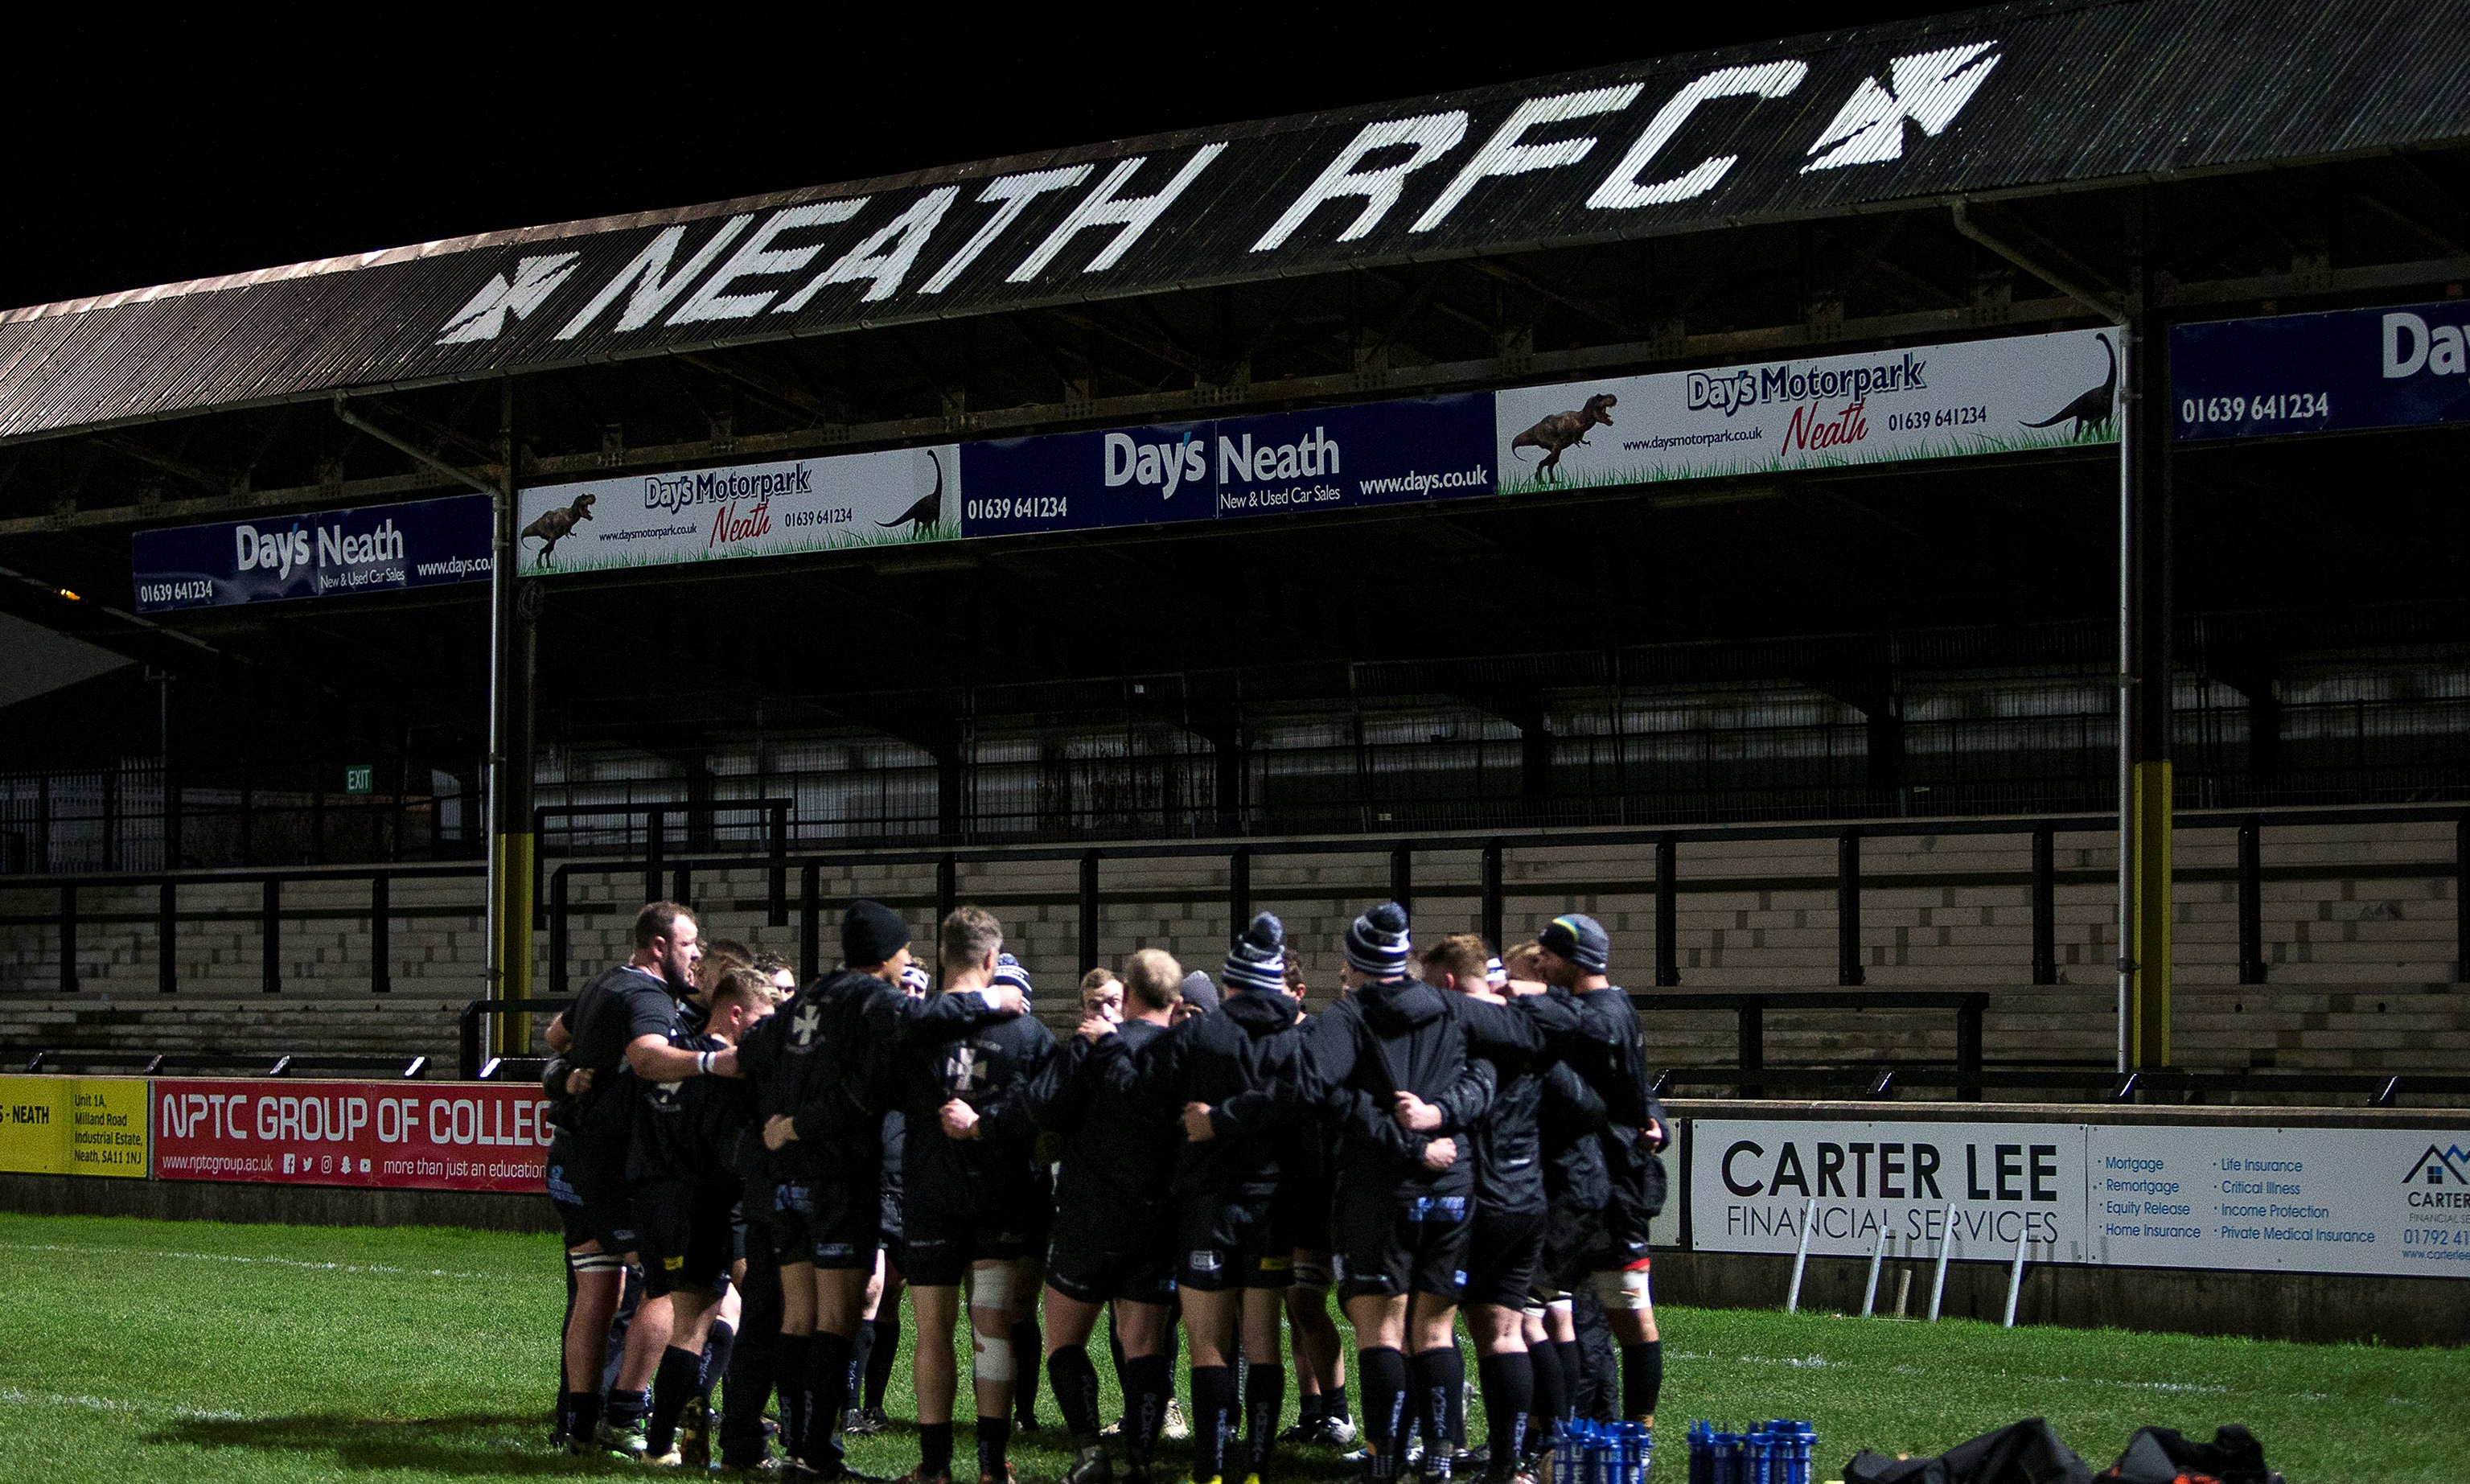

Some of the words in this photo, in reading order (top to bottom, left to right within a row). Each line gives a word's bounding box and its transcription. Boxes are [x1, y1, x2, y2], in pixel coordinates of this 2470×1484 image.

[553, 141, 1229, 340] NEATH
[1249, 60, 1808, 253] RFC
[1687, 369, 1757, 417] Day's
[1761, 354, 1927, 404] Motorpark
[2182, 397, 2245, 423] 01639
[2251, 391, 2329, 421] 641234
[1782, 397, 1869, 457] Neath
[1888, 411, 1930, 432] 01639
[1934, 406, 1987, 428] 641234
[1623, 426, 1762, 450] www.daysmotorpark.co.uk
[1104, 431, 1206, 500] Day's
[1219, 426, 1340, 484] Neath
[644, 475, 693, 515] Day's
[695, 462, 813, 504] Motorpark
[1359, 464, 1488, 495] www.days.co.uk
[1220, 492, 1247, 509] New
[1248, 492, 1258, 508] &
[1260, 488, 1288, 507] Used
[1291, 486, 1313, 504] Car
[1314, 484, 1341, 501] Sales
[785, 511, 814, 528] 01639
[816, 508, 853, 524] 641234
[968, 498, 1011, 520] 01639
[1014, 496, 1067, 518] 641234
[599, 523, 697, 541] www.daysmotorpark.co.uk
[709, 499, 772, 549] Neath
[236, 523, 310, 581] Day's
[318, 518, 404, 568] Neath
[321, 575, 340, 589] New
[340, 573, 347, 586] &
[348, 570, 368, 586] Used
[369, 569, 384, 582] Car
[386, 568, 405, 582] Sales
[141, 585, 172, 602] 01639
[175, 580, 212, 600] 641234
[348, 770, 370, 790] EXIT
[75, 1095, 92, 1107] Unit
[94, 1095, 107, 1108] 1A,
[13, 1105, 49, 1124] NEATH
[75, 1112, 105, 1126] Milland
[107, 1113, 127, 1126] Road
[163, 1094, 247, 1139] NPTC
[257, 1096, 368, 1141] GROUP
[377, 1098, 419, 1144] OF
[75, 1131, 113, 1145] Industrial
[115, 1133, 142, 1147] Estate,
[74, 1150, 100, 1164] Neath,
[102, 1151, 122, 1164] SA11
[162, 1154, 273, 1174] www.nptcgroup.ac.uk
[2106, 1157, 2164, 1173] Mortgage
[2221, 1158, 2241, 1171] Life
[2245, 1158, 2303, 1172] Insurance
[384, 1161, 413, 1175] more
[417, 1158, 442, 1176] than
[445, 1158, 468, 1180] just
[472, 1163, 486, 1177] an
[489, 1160, 546, 1178] education
[1721, 1140, 1943, 1199] CARTER
[1966, 1143, 2057, 1202] LEE
[2106, 1178, 2179, 1195] Remortgage
[2221, 1180, 2262, 1194] Critical
[2267, 1182, 2300, 1195] Illness
[2107, 1201, 2141, 1216] Equity
[2144, 1202, 2190, 1215] Release
[2407, 1191, 2470, 1208] CARTER
[2221, 1203, 2267, 1217] Income
[2270, 1204, 2329, 1219] Protection
[2409, 1213, 2459, 1223] FINANCIAL
[1728, 1205, 1897, 1239] FINANCIAL
[1906, 1208, 2058, 1244] SERVICES
[2106, 1223, 2140, 1236] Home
[2143, 1224, 2201, 1238] Insurance
[2221, 1225, 2260, 1239] Private
[2264, 1227, 2312, 1241] Medical
[2316, 1228, 2375, 1243] Insurance
[2404, 1229, 2448, 1245] 01792
